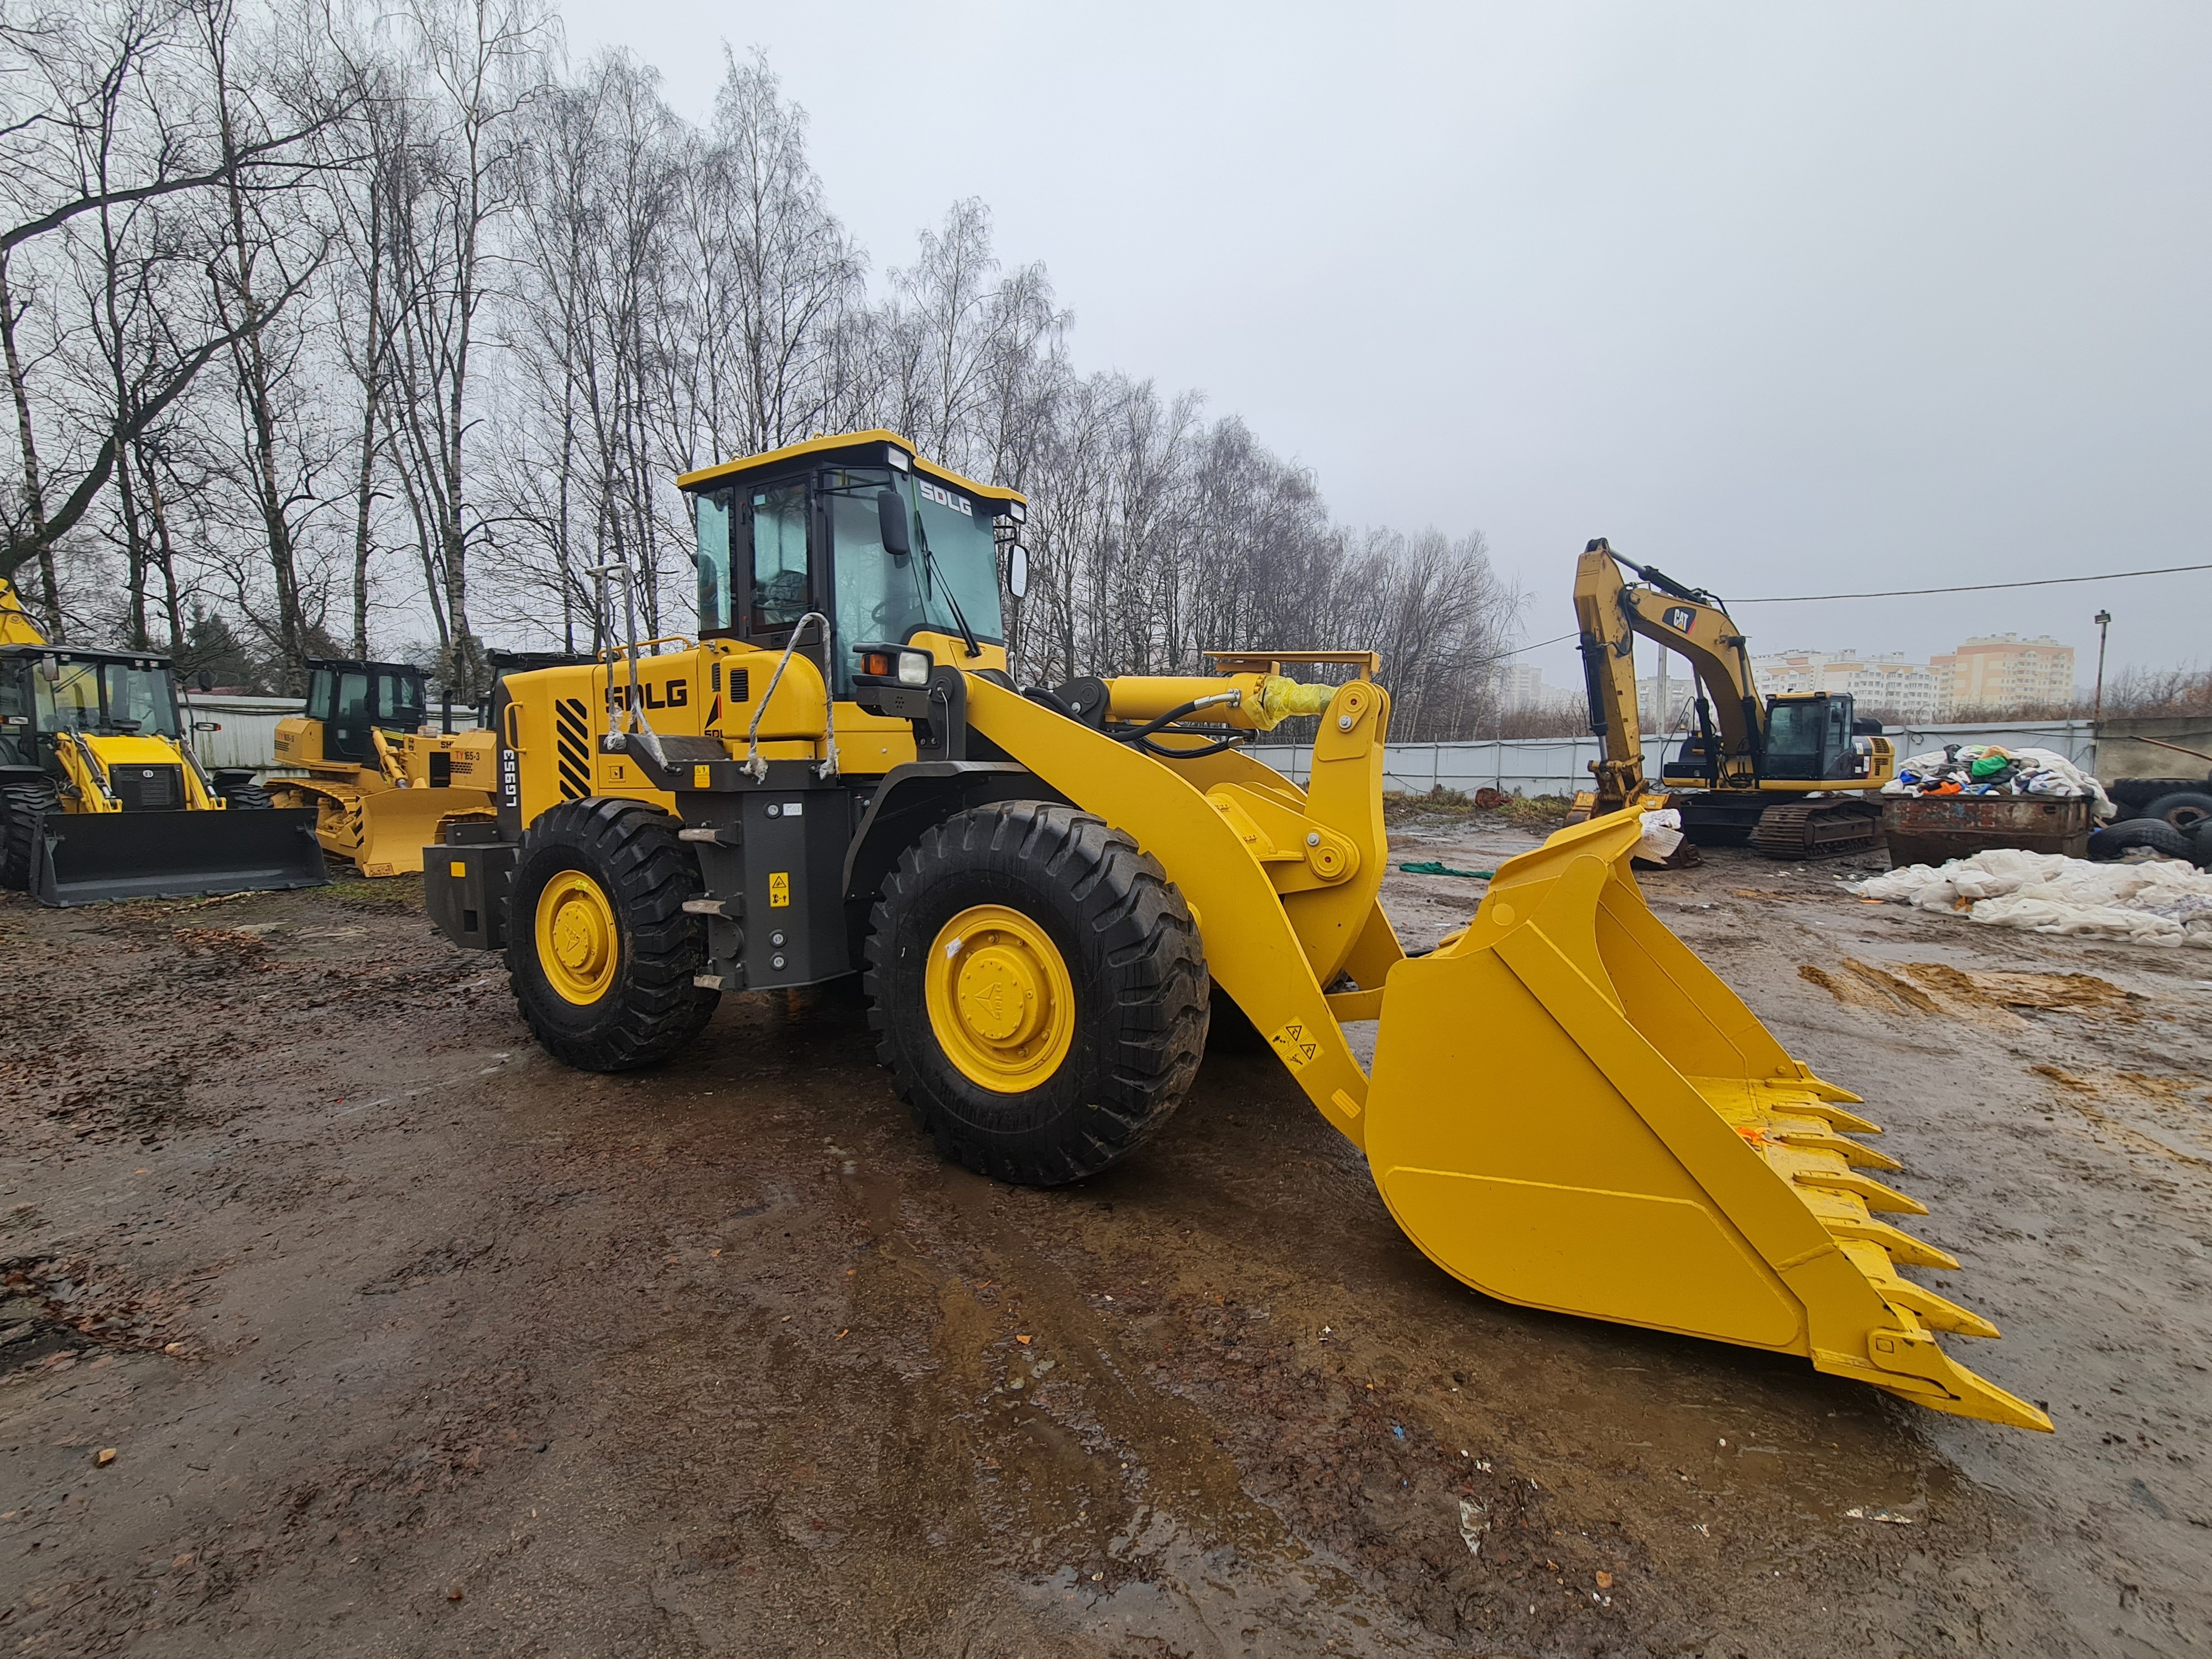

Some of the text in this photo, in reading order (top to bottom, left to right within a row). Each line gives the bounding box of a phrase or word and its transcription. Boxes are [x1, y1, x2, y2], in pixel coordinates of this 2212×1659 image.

[919, 479, 973, 517] SDLG
[1673, 608, 1689, 631] CAT
[604, 679, 687, 713] SDLG
[503, 749, 517, 807] LG953
